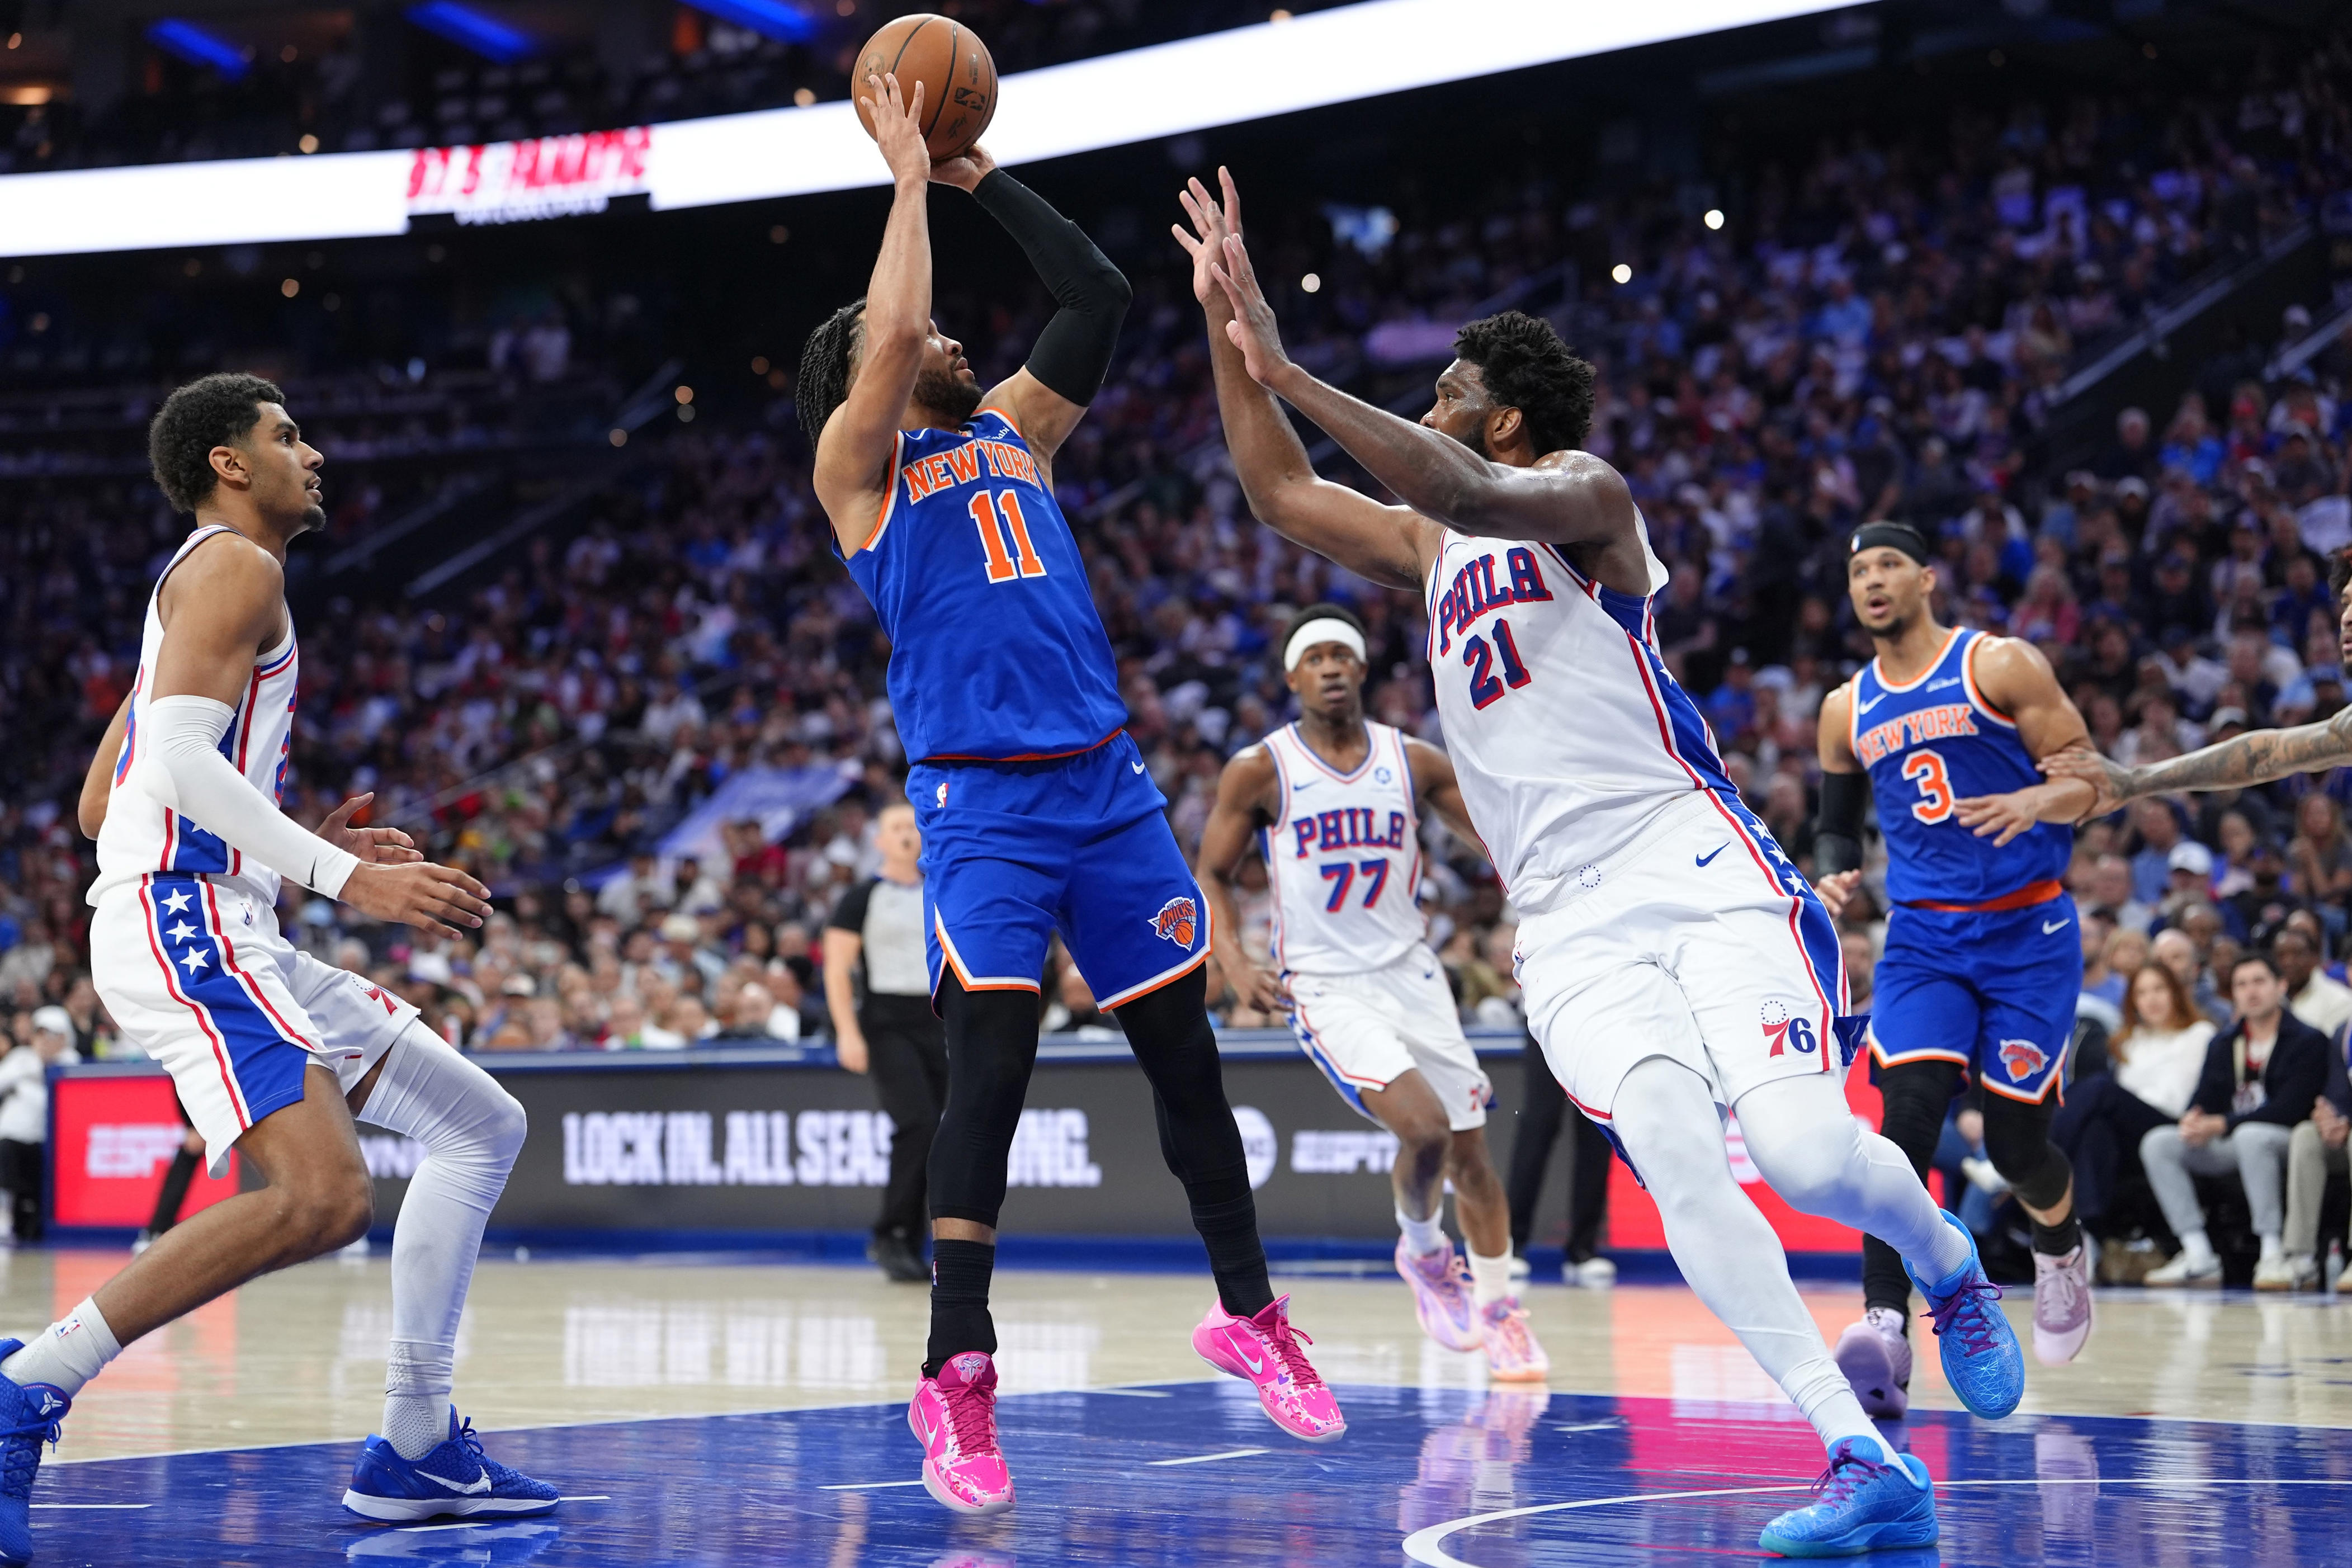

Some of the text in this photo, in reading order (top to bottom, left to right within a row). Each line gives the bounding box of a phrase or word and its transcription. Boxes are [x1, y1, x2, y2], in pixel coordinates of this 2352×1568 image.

[900, 438, 1043, 506] NEW YORK
[967, 489, 1047, 584] 11
[1439, 547, 1554, 658] PHILA
[1463, 618, 1532, 711] 21
[1857, 703, 1980, 770] NEW YORK
[1901, 748, 1956, 825] 3
[1292, 807, 1406, 859] PHILA
[1159, 900, 1196, 935] KNICKS
[1320, 858, 1390, 913] 77
[1761, 1017, 1816, 1058] 76
[563, 1111, 664, 1186] LOCK
[665, 1111, 723, 1186] IN.
[724, 1110, 795, 1186] ALL
